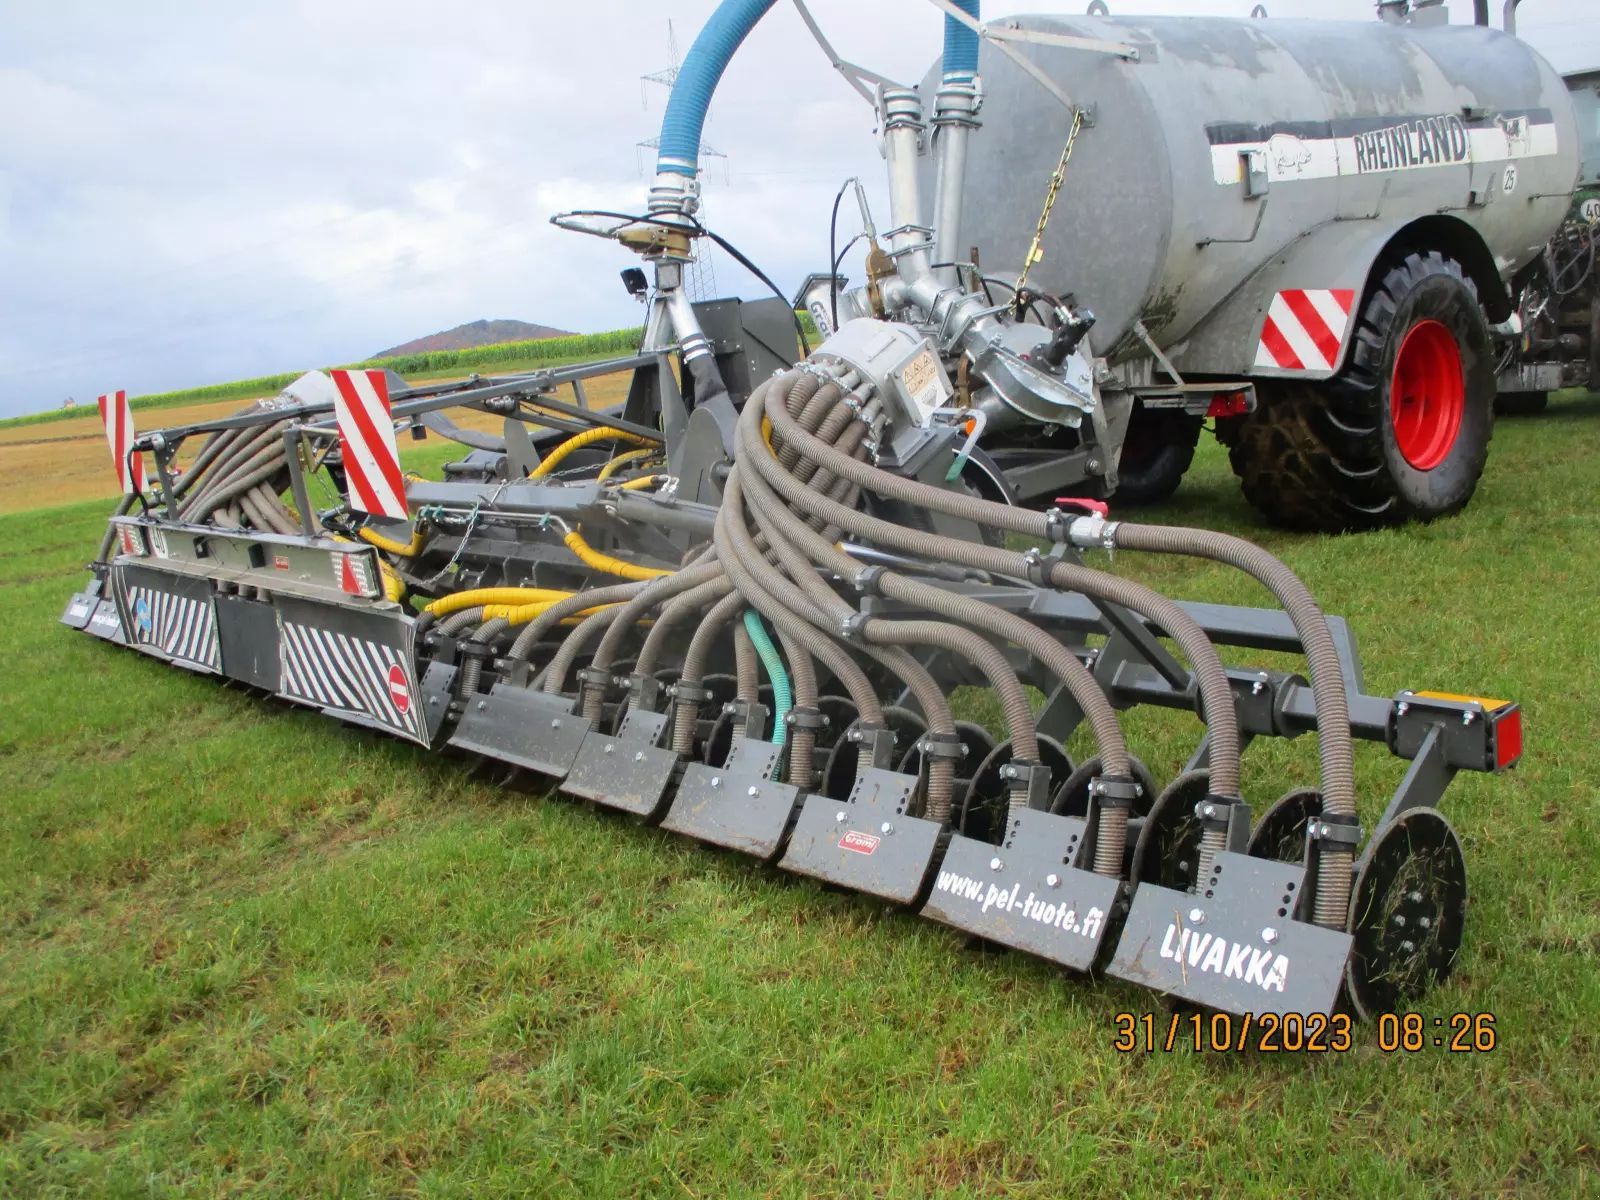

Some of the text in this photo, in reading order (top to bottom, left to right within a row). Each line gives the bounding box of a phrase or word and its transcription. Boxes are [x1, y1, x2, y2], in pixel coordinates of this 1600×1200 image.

[1354, 114, 1467, 174] RHEINLAND
[1503, 169, 1515, 191] 25
[1586, 203, 1600, 219] 40
[937, 870, 1104, 939] www.pel-tuote.fi
[1159, 923, 1289, 993] LIVAKKA
